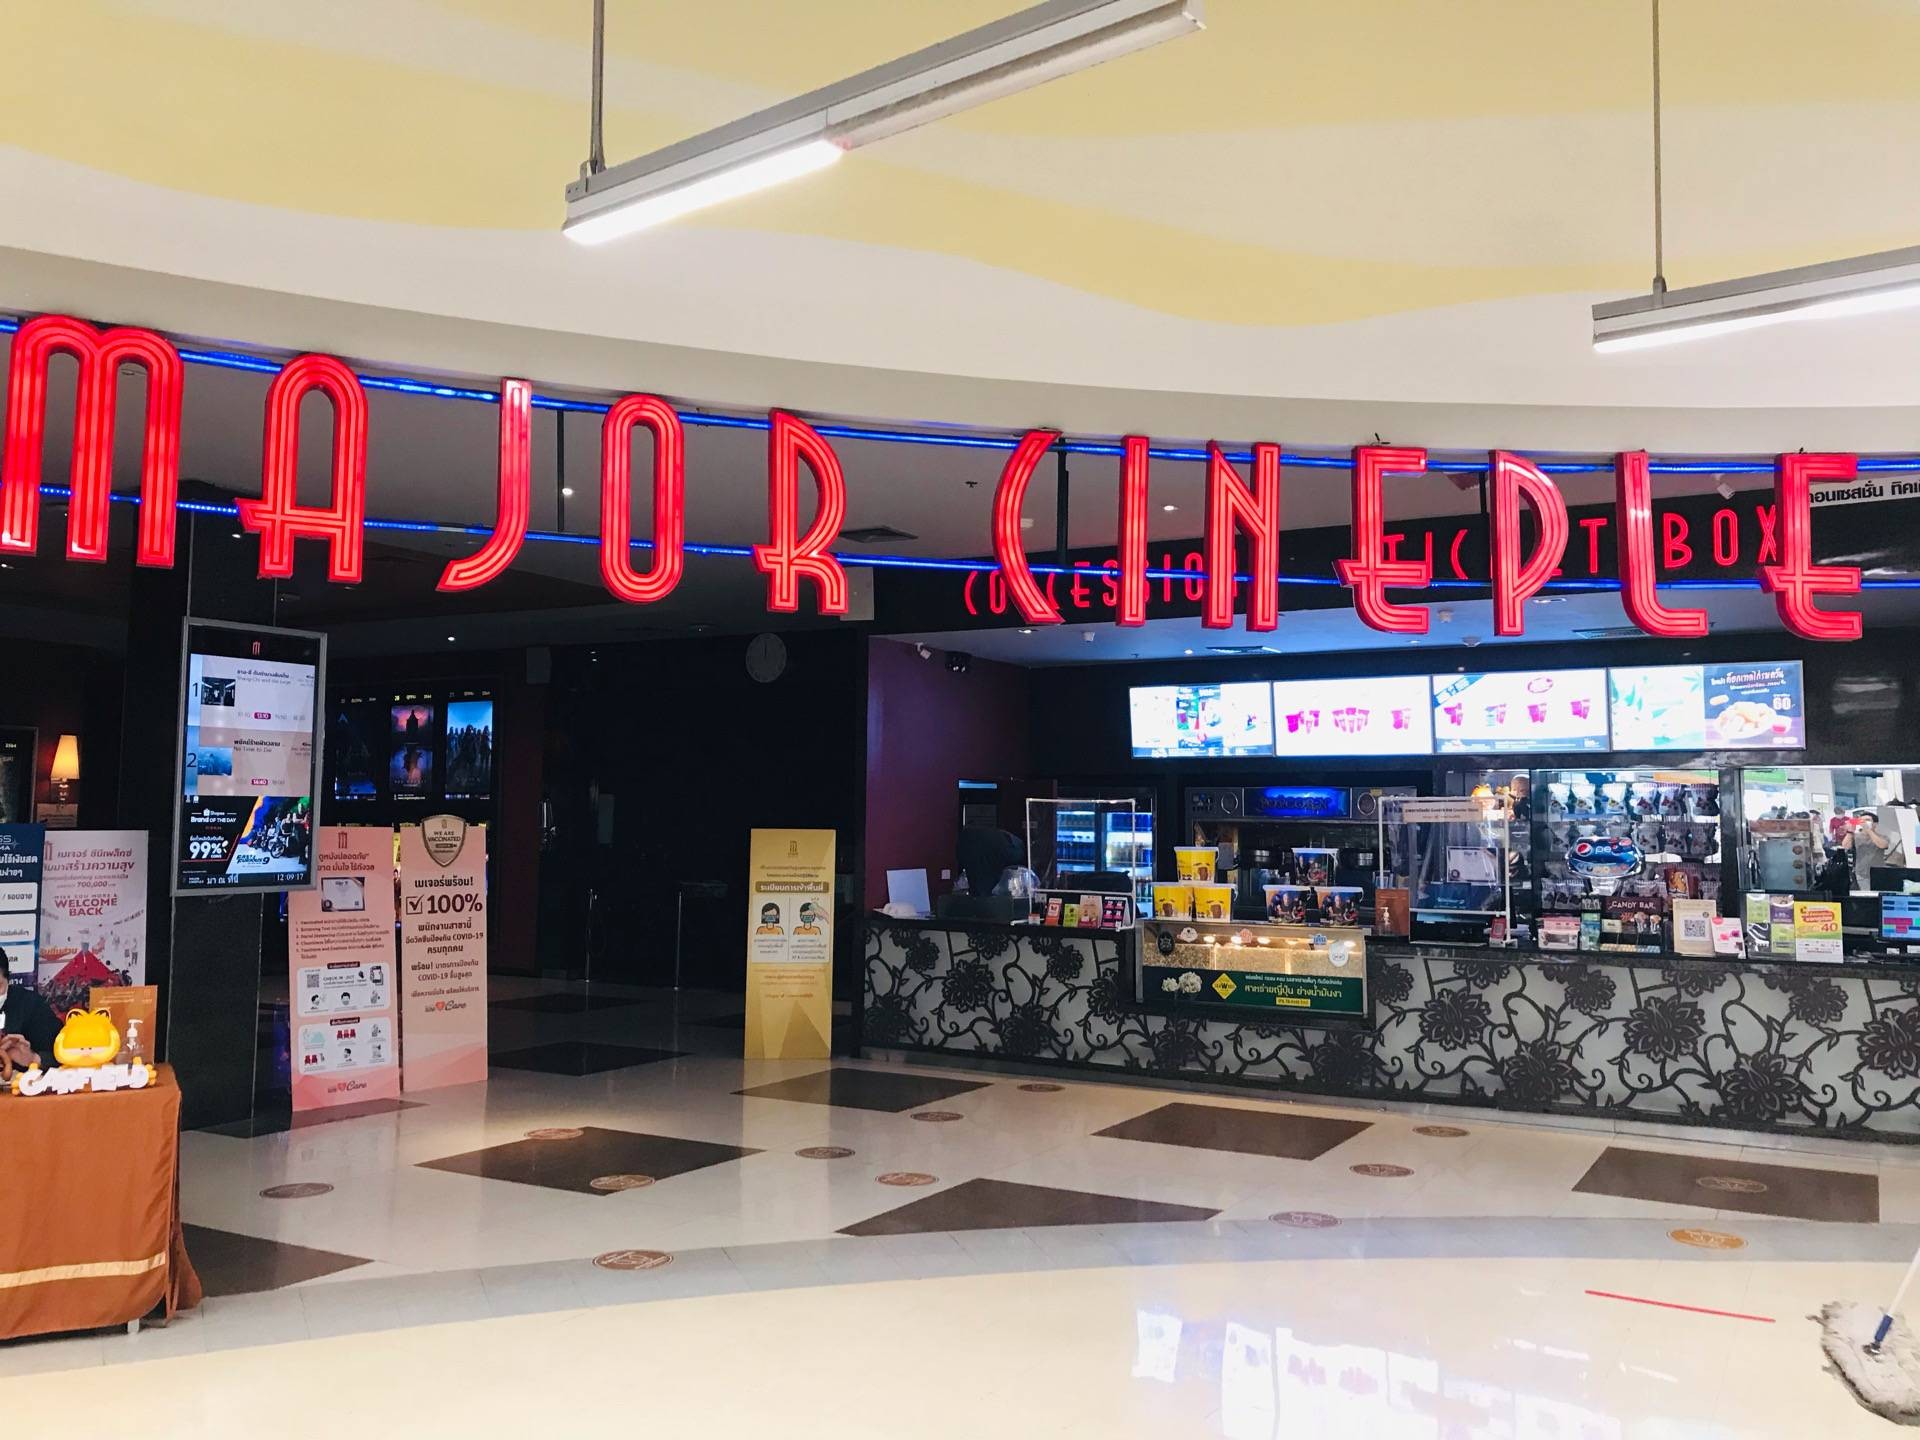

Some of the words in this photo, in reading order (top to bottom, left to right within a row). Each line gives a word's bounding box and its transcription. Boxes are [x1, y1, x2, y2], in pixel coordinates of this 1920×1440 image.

[0, 314, 848, 616] MAJOR
[1381, 518, 1608, 580] TICT
[1664, 505, 1777, 568] BOX
[192, 682, 198, 697] 1
[187, 753, 197, 767] 2
[57, 848, 88, 859] เมเจอร์
[189, 841, 222, 859] 99%
[277, 873, 304, 881] 12:09:17
[415, 875, 474, 888] เมเจอร์พร้อม!
[54, 898, 118, 908] WELCOME
[427, 893, 483, 914] 100%
[1611, 901, 1637, 909] CANDY
[1640, 901, 1655, 909] BAR
[69, 907, 104, 917] BACK
[1821, 923, 1838, 932] 40
[452, 932, 484, 941] COVID-19
[427, 945, 464, 955] ครบทุกคน
[418, 973, 448, 981] COVID-19
[445, 1000, 466, 1011] Care
